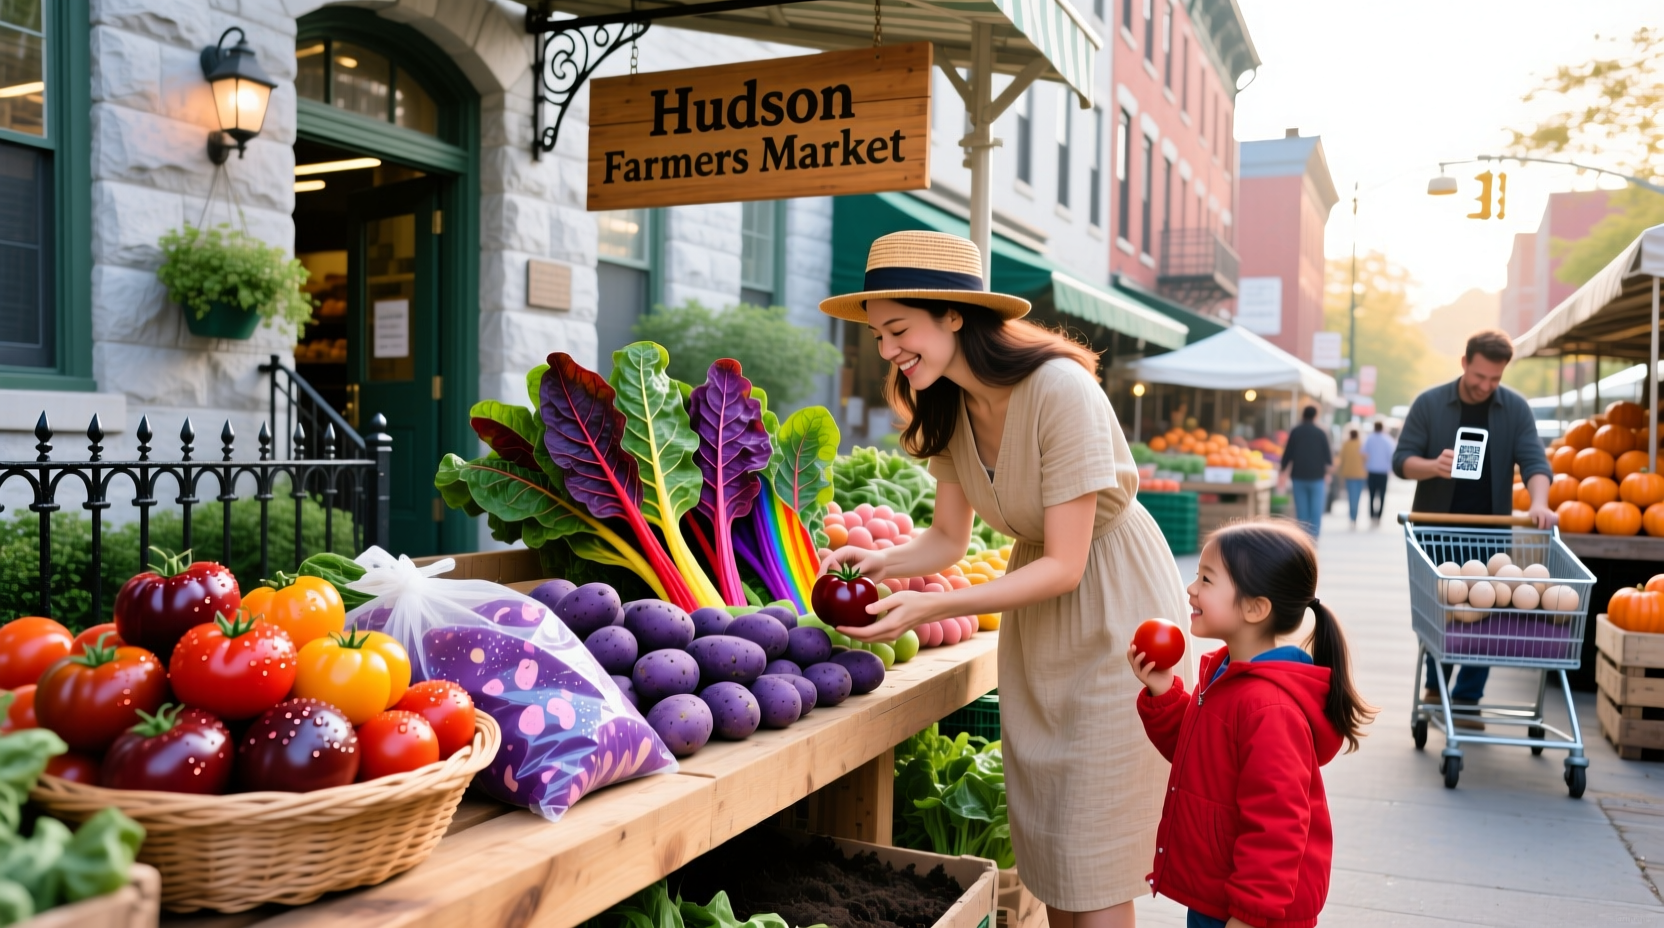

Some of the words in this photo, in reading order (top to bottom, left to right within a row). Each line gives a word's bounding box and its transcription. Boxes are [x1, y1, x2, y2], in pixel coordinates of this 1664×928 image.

[650, 79, 855, 136] Hudson
[603, 147, 749, 184] Farmers
[759, 129, 906, 172] Market
